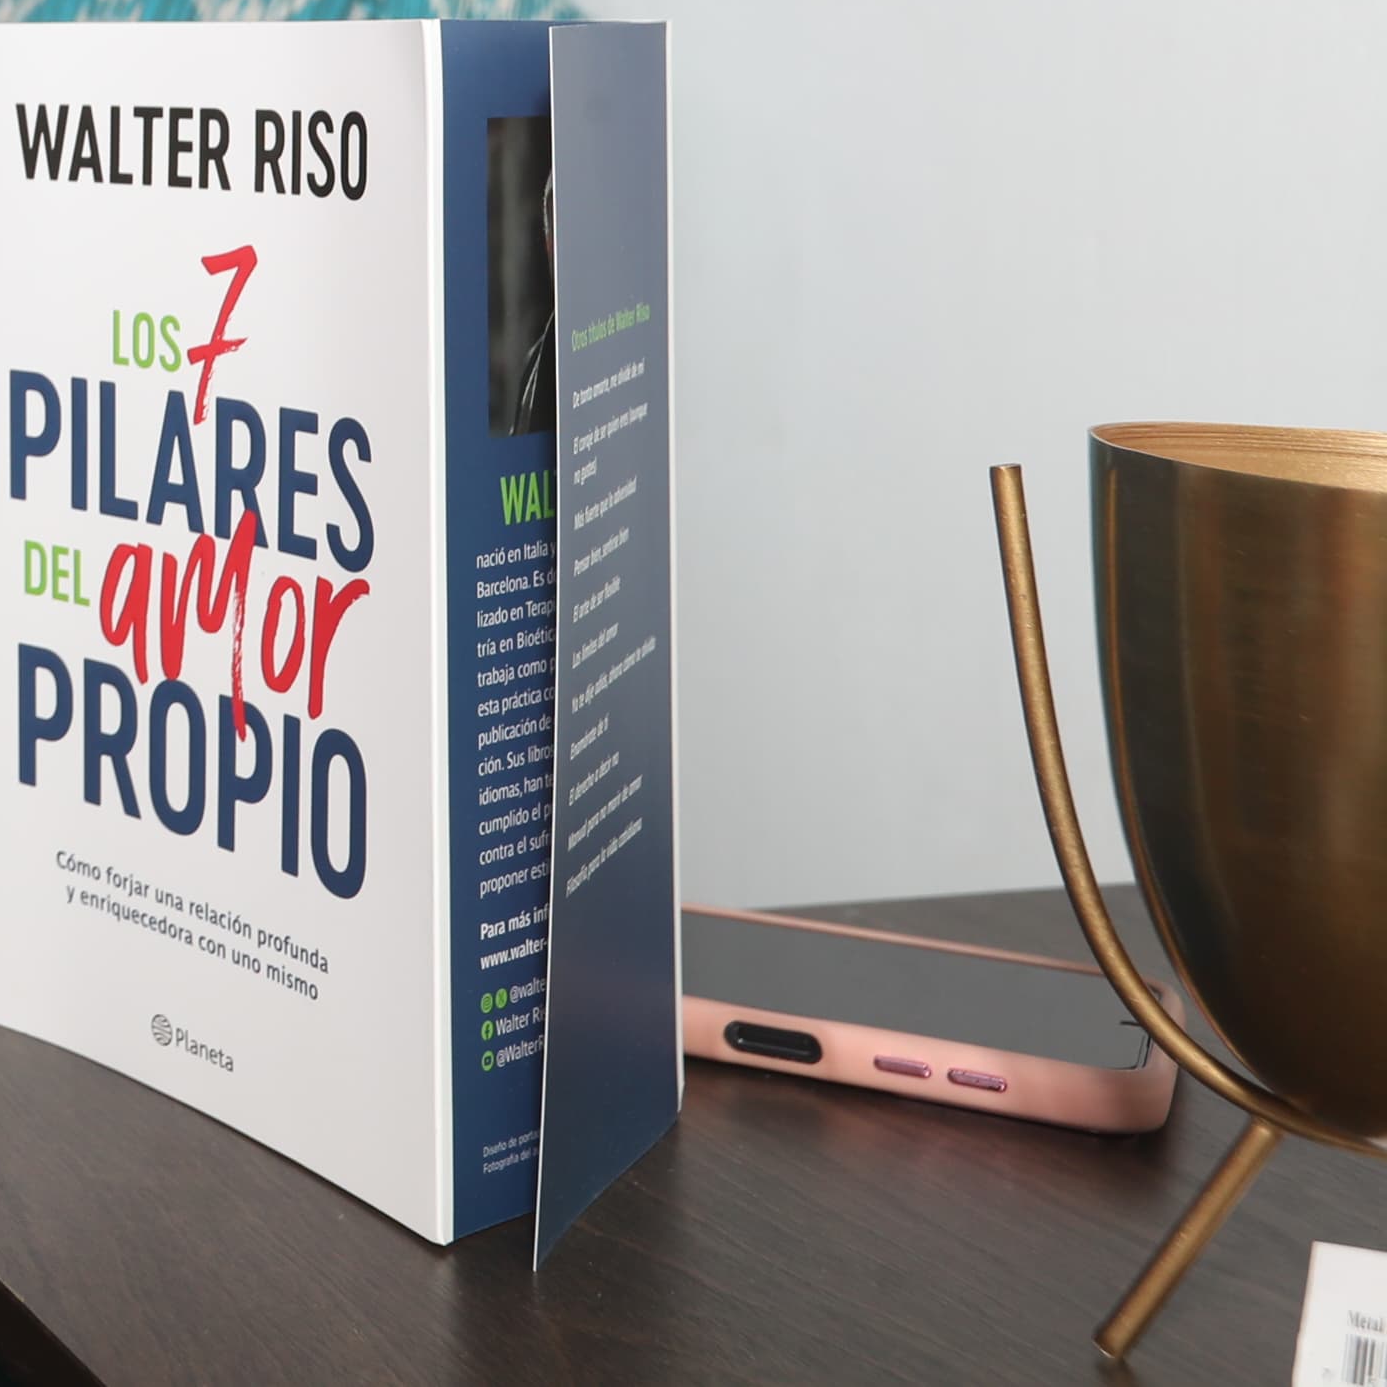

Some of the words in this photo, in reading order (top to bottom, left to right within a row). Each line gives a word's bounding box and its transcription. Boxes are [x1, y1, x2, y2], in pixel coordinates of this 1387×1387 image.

[15, 103, 232, 191] WALTER
[254, 108, 368, 201] RISO
[112, 309, 182, 372] LOS
[187, 244, 258, 425] 7
[10, 369, 375, 573] PILARES
[500, 470, 556, 525] WAL
[476, 547, 505, 569] nació
[507, 547, 521, 563] en
[524, 539, 548, 560] Italia
[476, 575, 531, 598] Barcelona.
[533, 570, 545, 587] Es
[24, 539, 90, 607] DEL
[100, 509, 370, 742] amor
[476, 606, 508, 628] lizado
[510, 606, 523, 621] en
[477, 638, 496, 658] tría
[499, 637, 513, 653] en
[477, 664, 515, 687] trabaja
[517, 659, 547, 678] como
[477, 699, 499, 717] esta
[501, 688, 541, 715] práctica
[478, 717, 537, 750] publicación
[539, 713, 551, 731] de
[18, 642, 368, 900] PROPIO
[478, 756, 504, 776] ción.
[507, 751, 525, 770] Sus
[478, 782, 523, 806] idiomas,
[524, 774, 543, 794] han
[479, 808, 529, 836] cumplido
[532, 802, 540, 821] el
[479, 843, 515, 865] contra
[517, 836, 527, 855] el
[480, 867, 529, 899] proponer
[56, 850, 101, 881] Cómo
[106, 866, 151, 898] forjar
[155, 888, 184, 912] una
[189, 900, 252, 940] relación
[257, 928, 329, 974] profunda
[480, 920, 506, 940] Para
[508, 911, 531, 932] más
[66, 884, 76, 905] y
[80, 888, 194, 946] enriquecedora
[198, 933, 226, 960] con
[231, 947, 261, 974] uno
[266, 962, 319, 1001] mismo
[496, 1013, 530, 1036] Walter
[175, 1027, 234, 1073] Planeta
